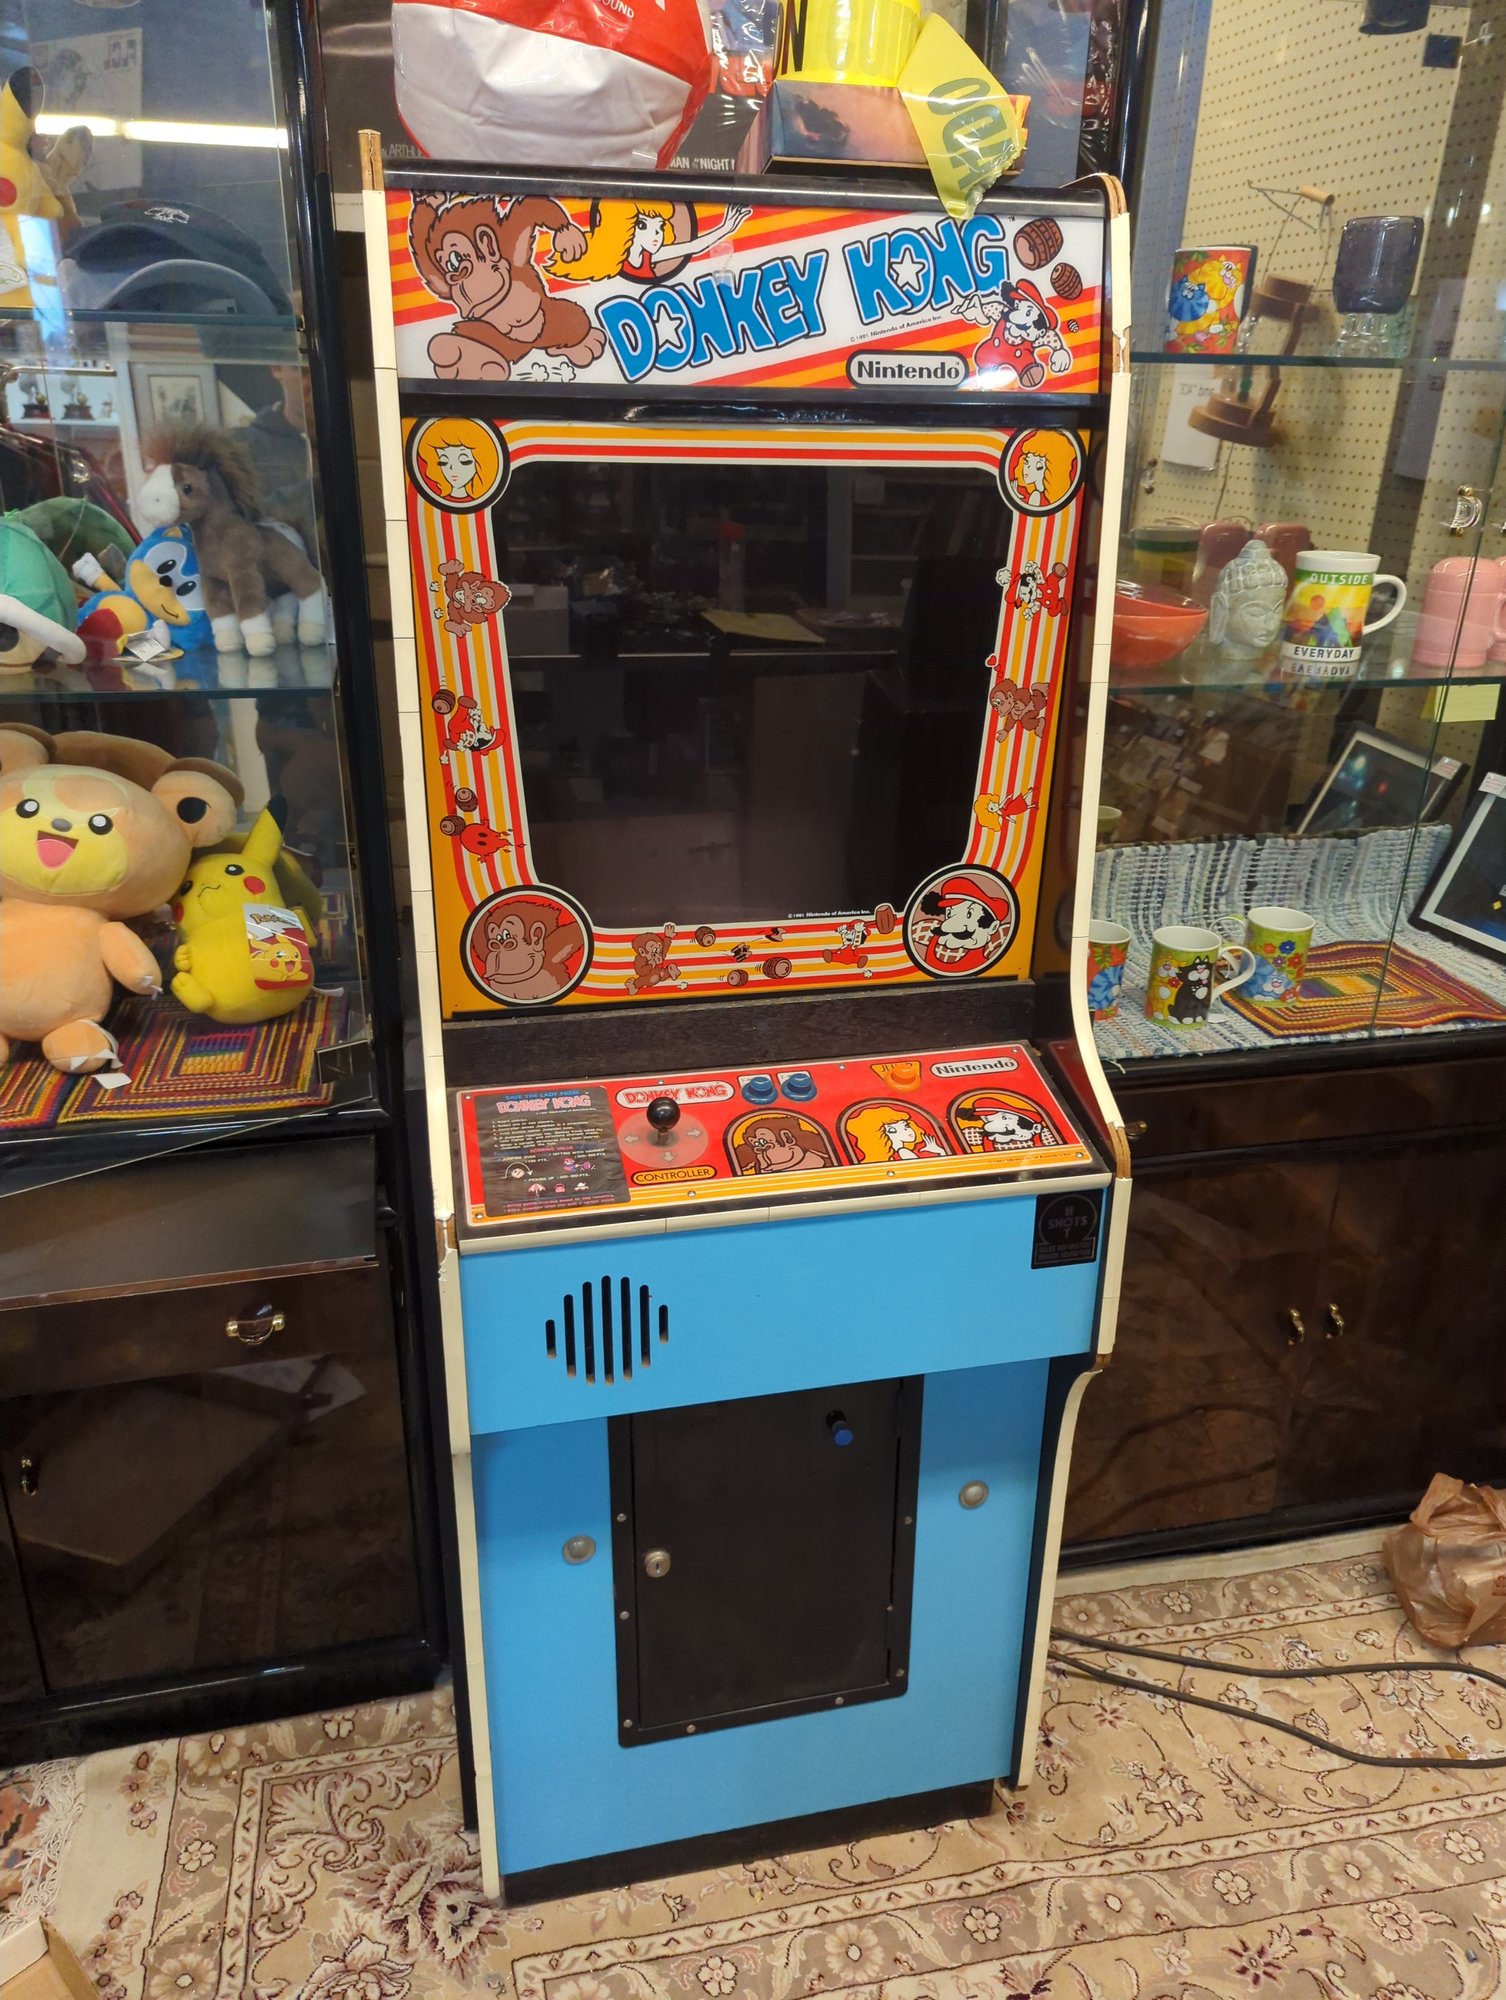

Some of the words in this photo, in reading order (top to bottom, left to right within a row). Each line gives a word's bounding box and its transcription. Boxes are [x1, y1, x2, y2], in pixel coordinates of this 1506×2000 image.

[600, 0, 635, 20] OUND
[389, 144, 424, 158] ARTHU
[596, 248, 829, 384] DONKEY
[843, 214, 1009, 326] KONG
[870, 326, 898, 337] Nintendo
[906, 318, 932, 328] America
[856, 359, 961, 382] Nintendo
[1310, 573, 1368, 584] OUTSIDE
[1294, 646, 1355, 659] EVERYDAY
[934, 1060, 1016, 1076] Nintendo
[624, 1089, 681, 1104] DONKEY
[685, 1084, 728, 1100] KONG
[496, 1098, 550, 1114] DONKEY
[553, 1094, 592, 1109] KONG
[635, 1167, 711, 1183] CONTROLLER
